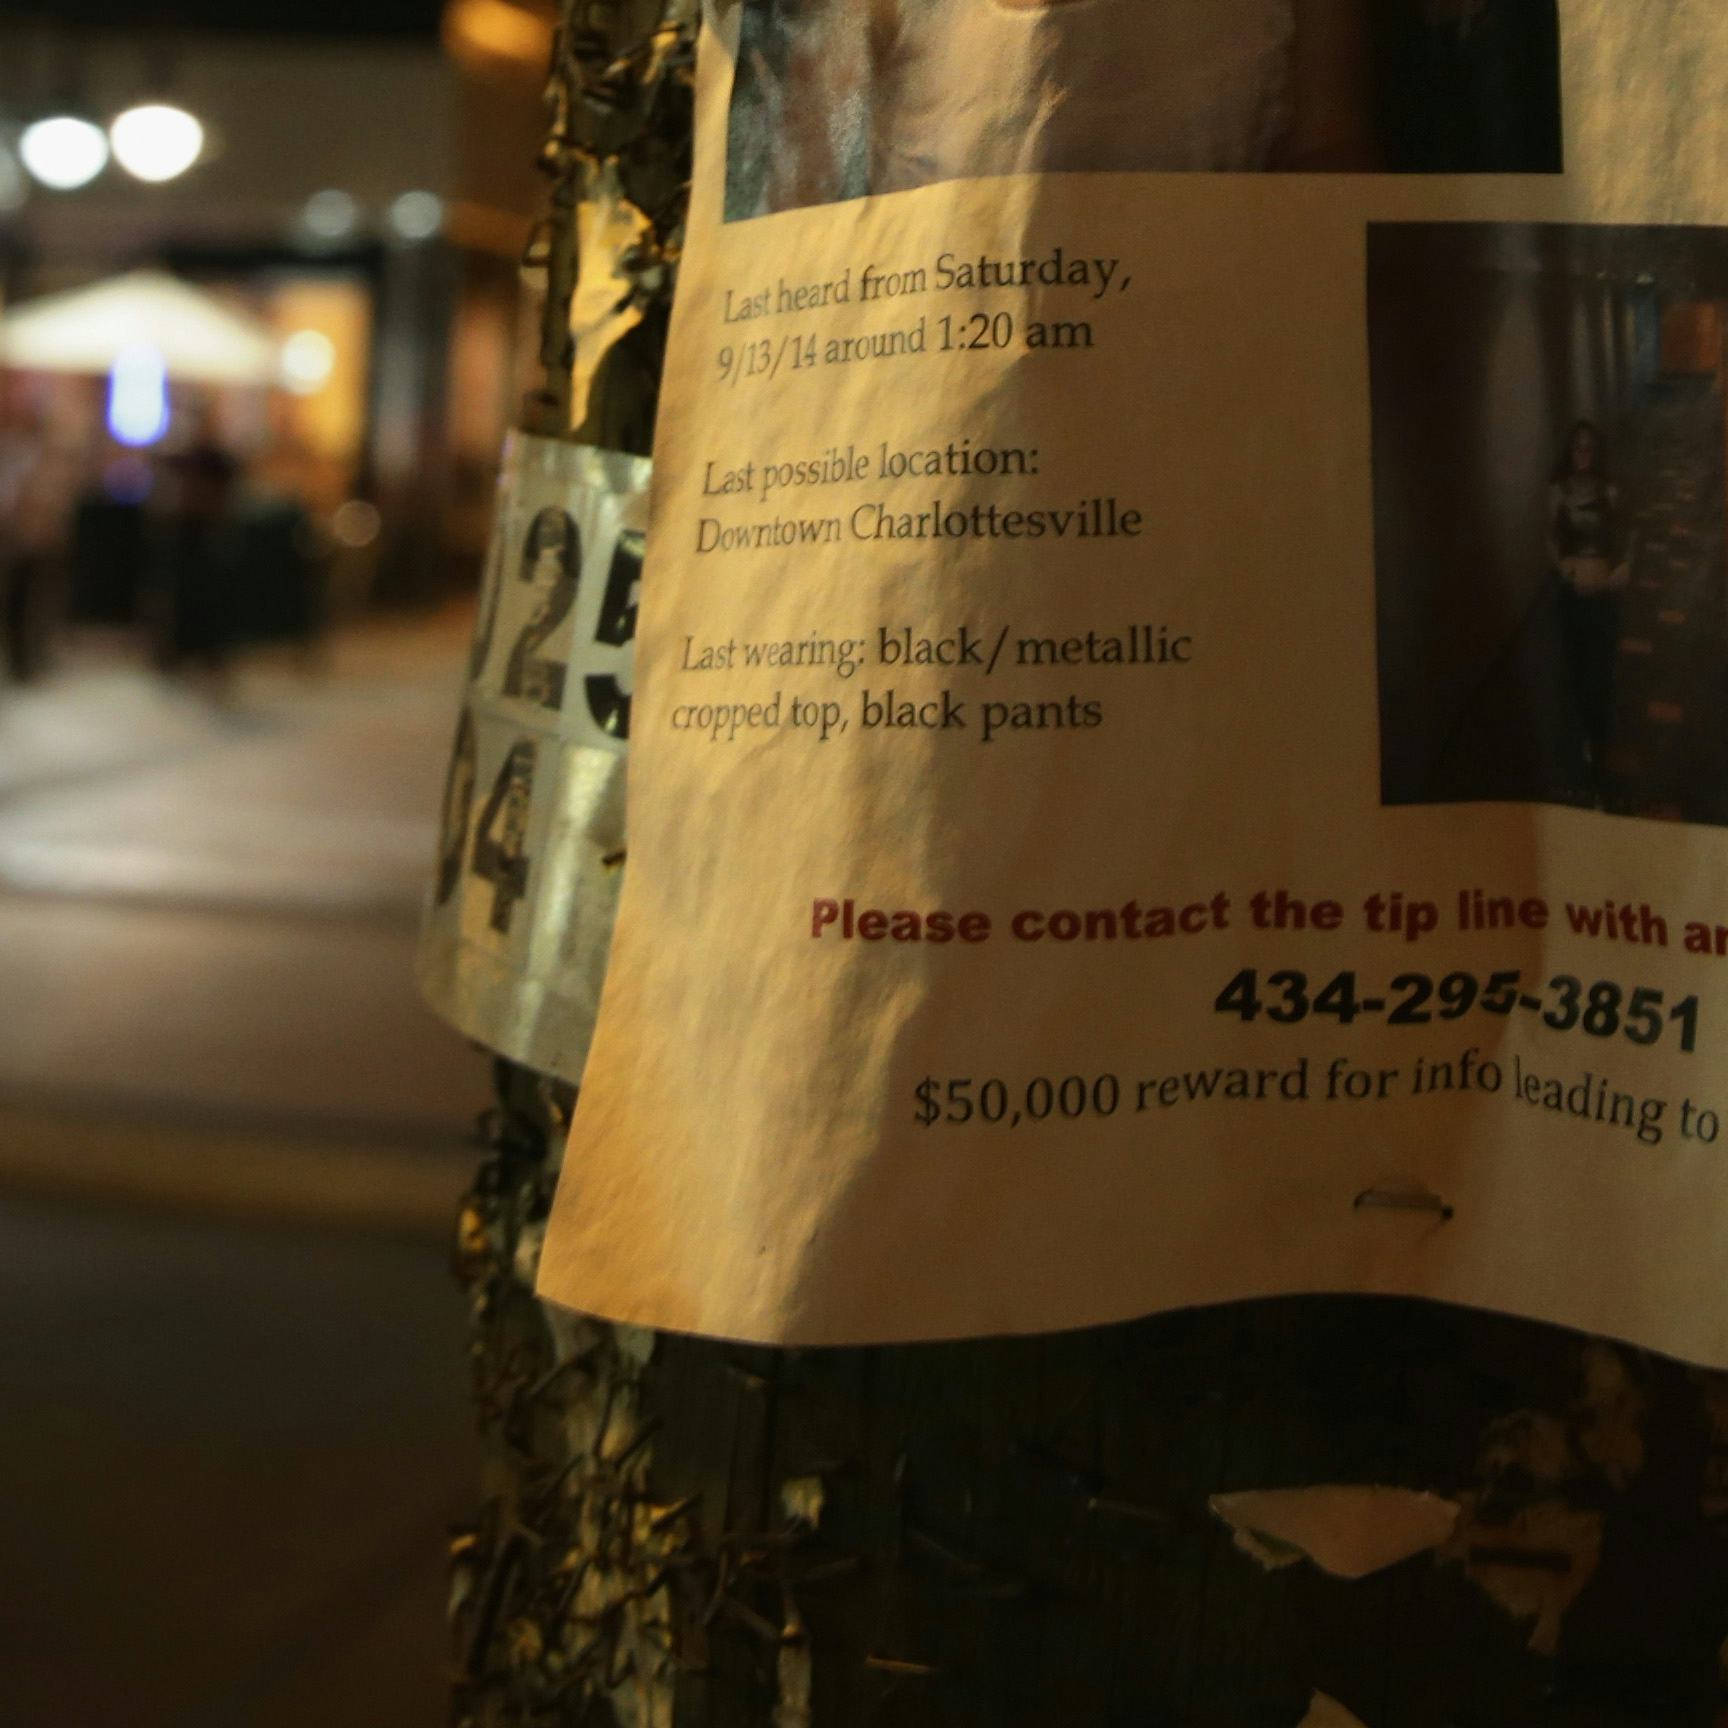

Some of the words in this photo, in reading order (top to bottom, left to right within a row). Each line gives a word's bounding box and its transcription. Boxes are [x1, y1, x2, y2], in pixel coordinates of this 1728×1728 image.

[724, 289, 770, 325] Last
[776, 267, 851, 315] heard
[859, 265, 928, 302] from
[934, 248, 1131, 300] Saturday,
[717, 334, 818, 387] 9/13/14
[825, 317, 927, 364] around
[938, 312, 1013, 351] 1:20
[1026, 319, 1095, 348] am
[702, 461, 754, 498] Last
[762, 447, 869, 502] possible
[877, 439, 1040, 477] location:
[696, 518, 841, 555] Downtown
[850, 498, 1143, 541] Charlottesville
[682, 635, 735, 672] Last
[744, 630, 867, 679] wearing:
[672, 691, 780, 740] cropped
[791, 697, 847, 740] top,
[861, 691, 967, 729] black
[980, 694, 1103, 742] pants
[810, 897, 992, 943] Please
[1011, 890, 1230, 942] contact
[1250, 890, 1343, 930] the
[1364, 891, 1438, 941] tip
[1458, 890, 1549, 930] line
[1566, 901, 1669, 948] with
[1214, 969, 1699, 1053] 434-295-3851
[914, 1074, 1120, 1128] $50,000
[1136, 1058, 1309, 1113] reward
[1326, 1058, 1398, 1100] for
[1413, 1047, 1502, 1094] info
[1514, 1055, 1667, 1143] leading
[1680, 1096, 1719, 1142] to
